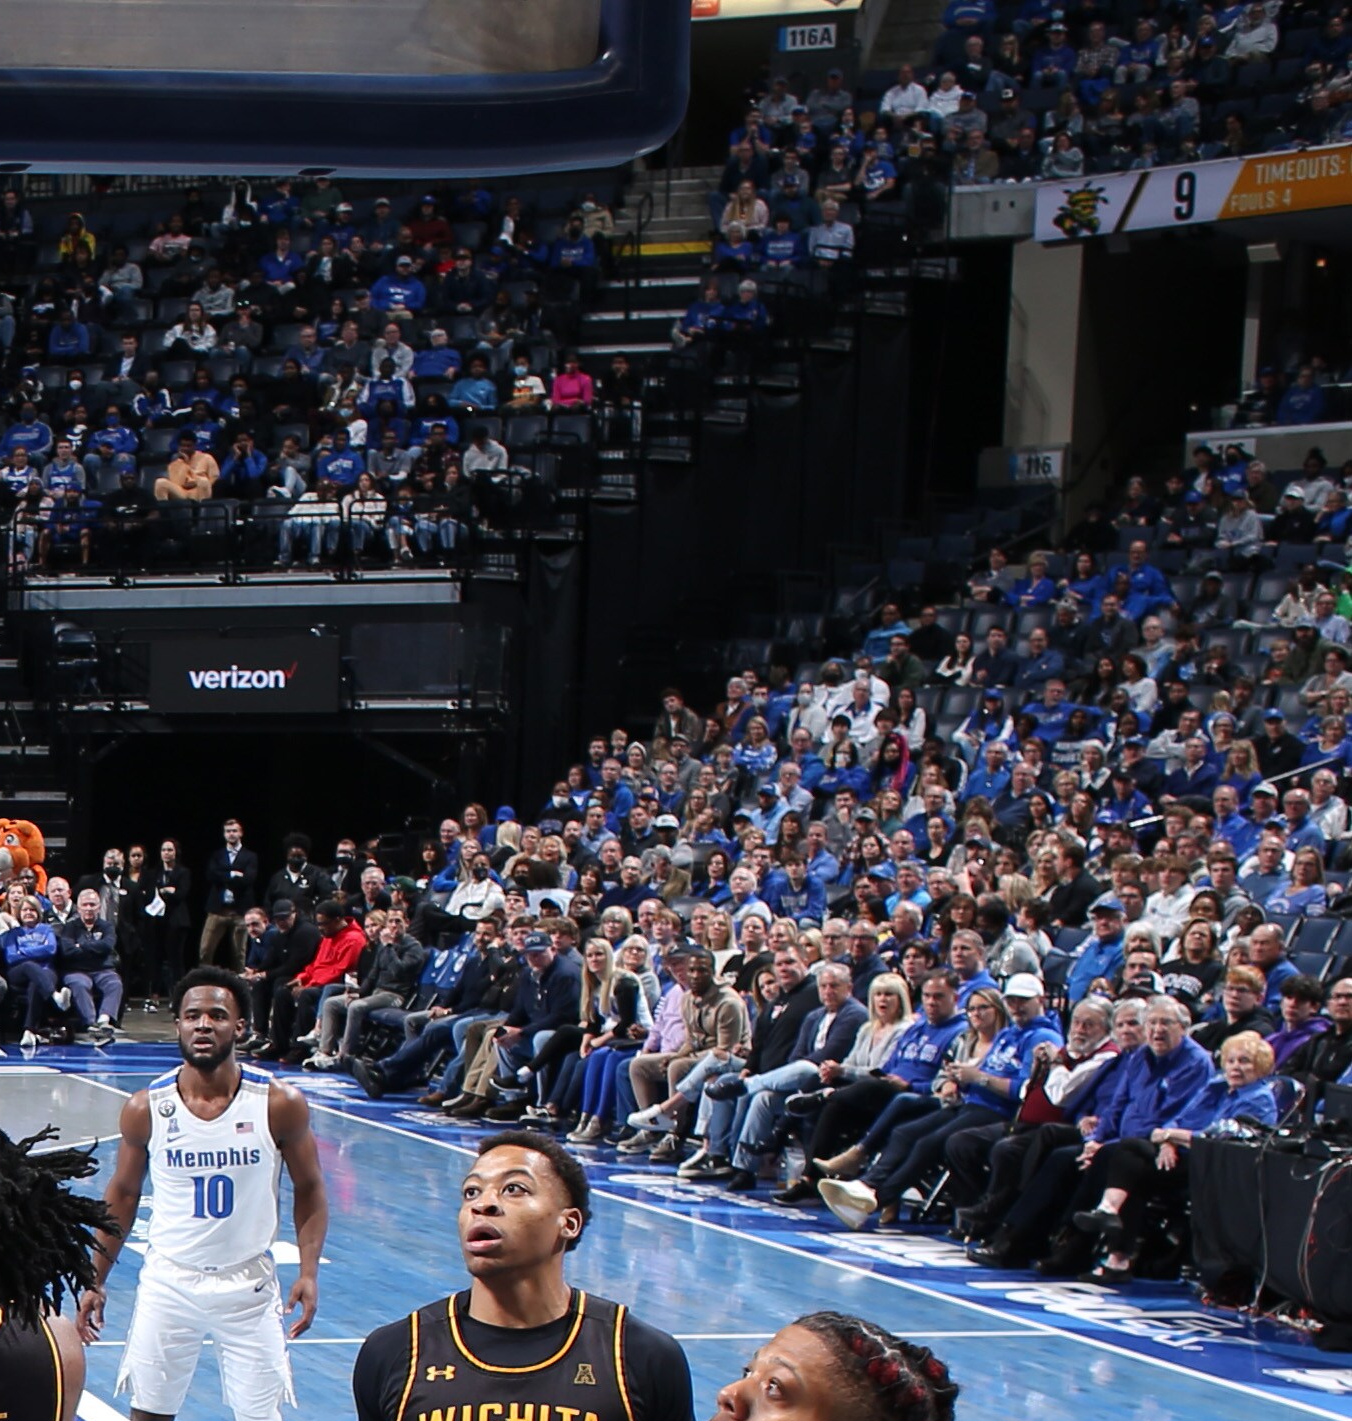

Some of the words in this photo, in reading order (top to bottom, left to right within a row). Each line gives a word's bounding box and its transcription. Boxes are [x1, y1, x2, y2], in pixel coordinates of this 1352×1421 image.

[790, 27, 833, 47] 116A
[1174, 171, 1197, 221] 9
[1025, 455, 1052, 476] 116
[189, 664, 286, 689] verizon
[165, 1147, 261, 1169] Memphis
[190, 1174, 234, 1219] 10
